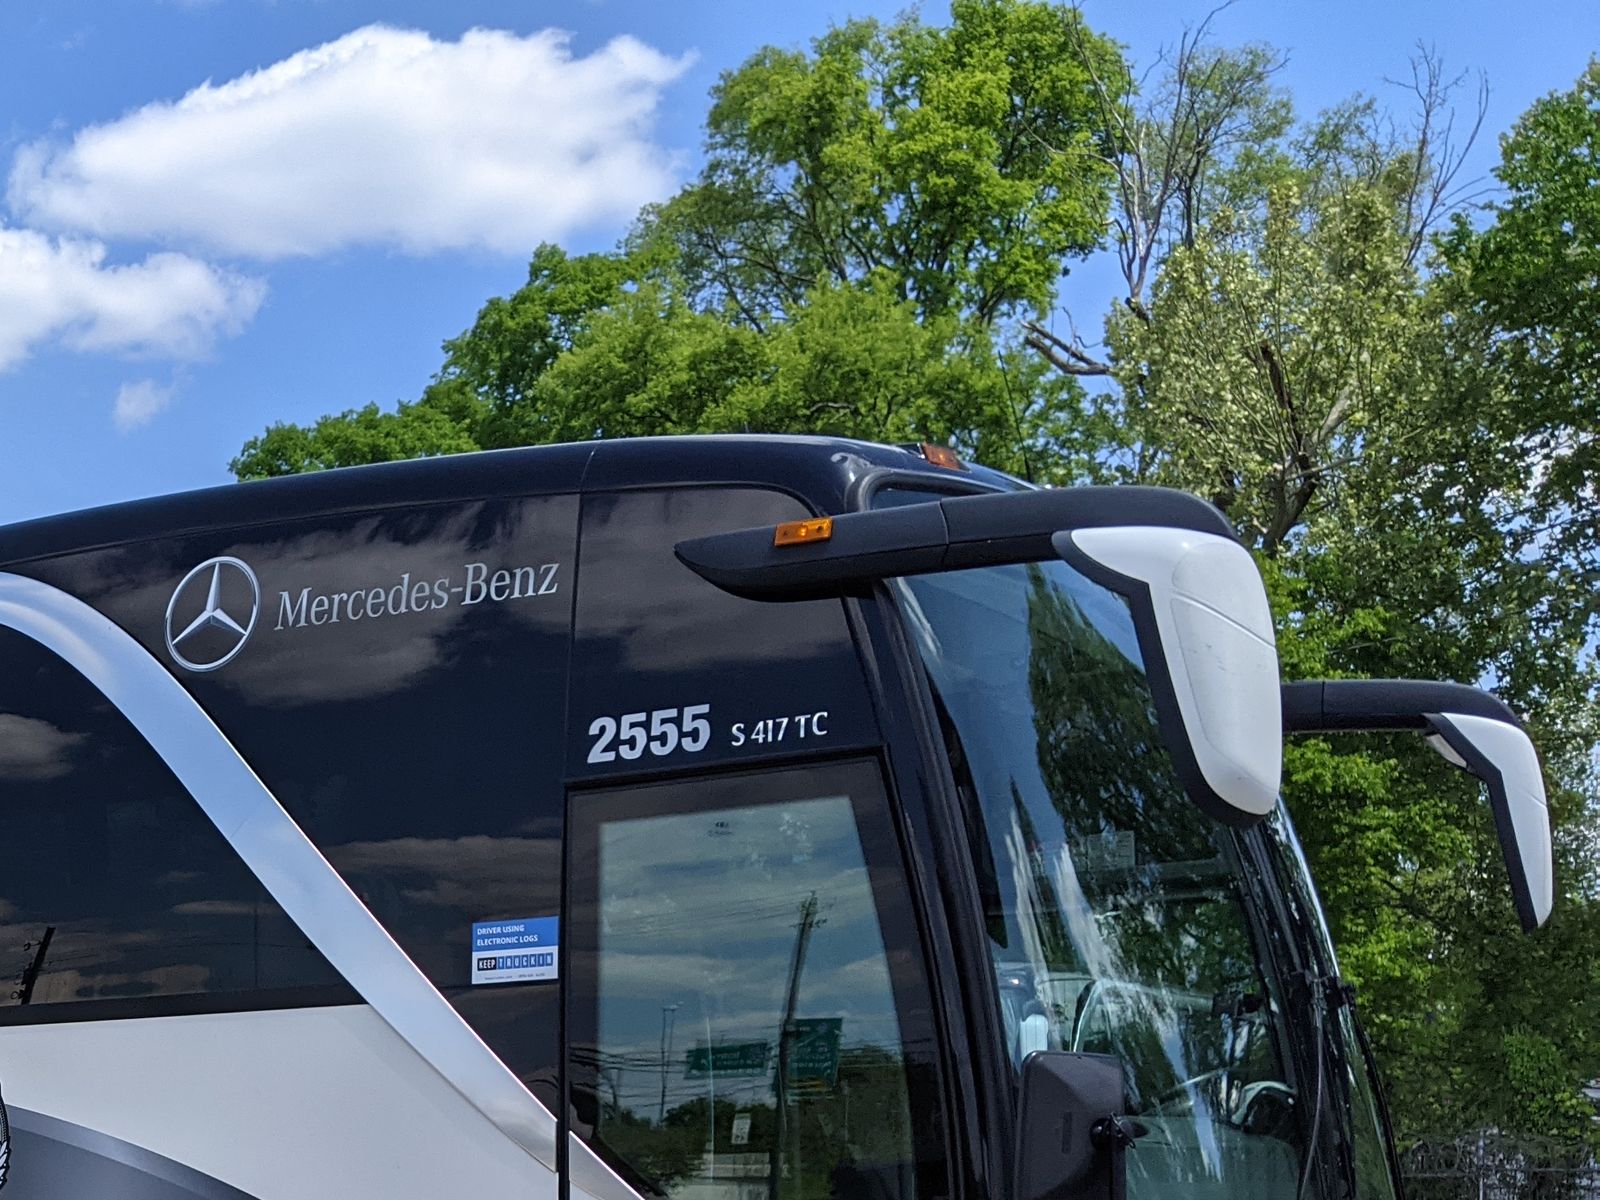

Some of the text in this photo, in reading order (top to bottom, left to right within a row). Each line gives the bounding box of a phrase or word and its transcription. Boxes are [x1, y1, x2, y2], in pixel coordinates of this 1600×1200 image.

[273, 562, 560, 631] Mercedes-Benz
[587, 703, 828, 764] 2555 S 417 TC
[477, 925, 525, 936] DRIVER USING
[477, 934, 538, 946] ELECTRONIC LOGS
